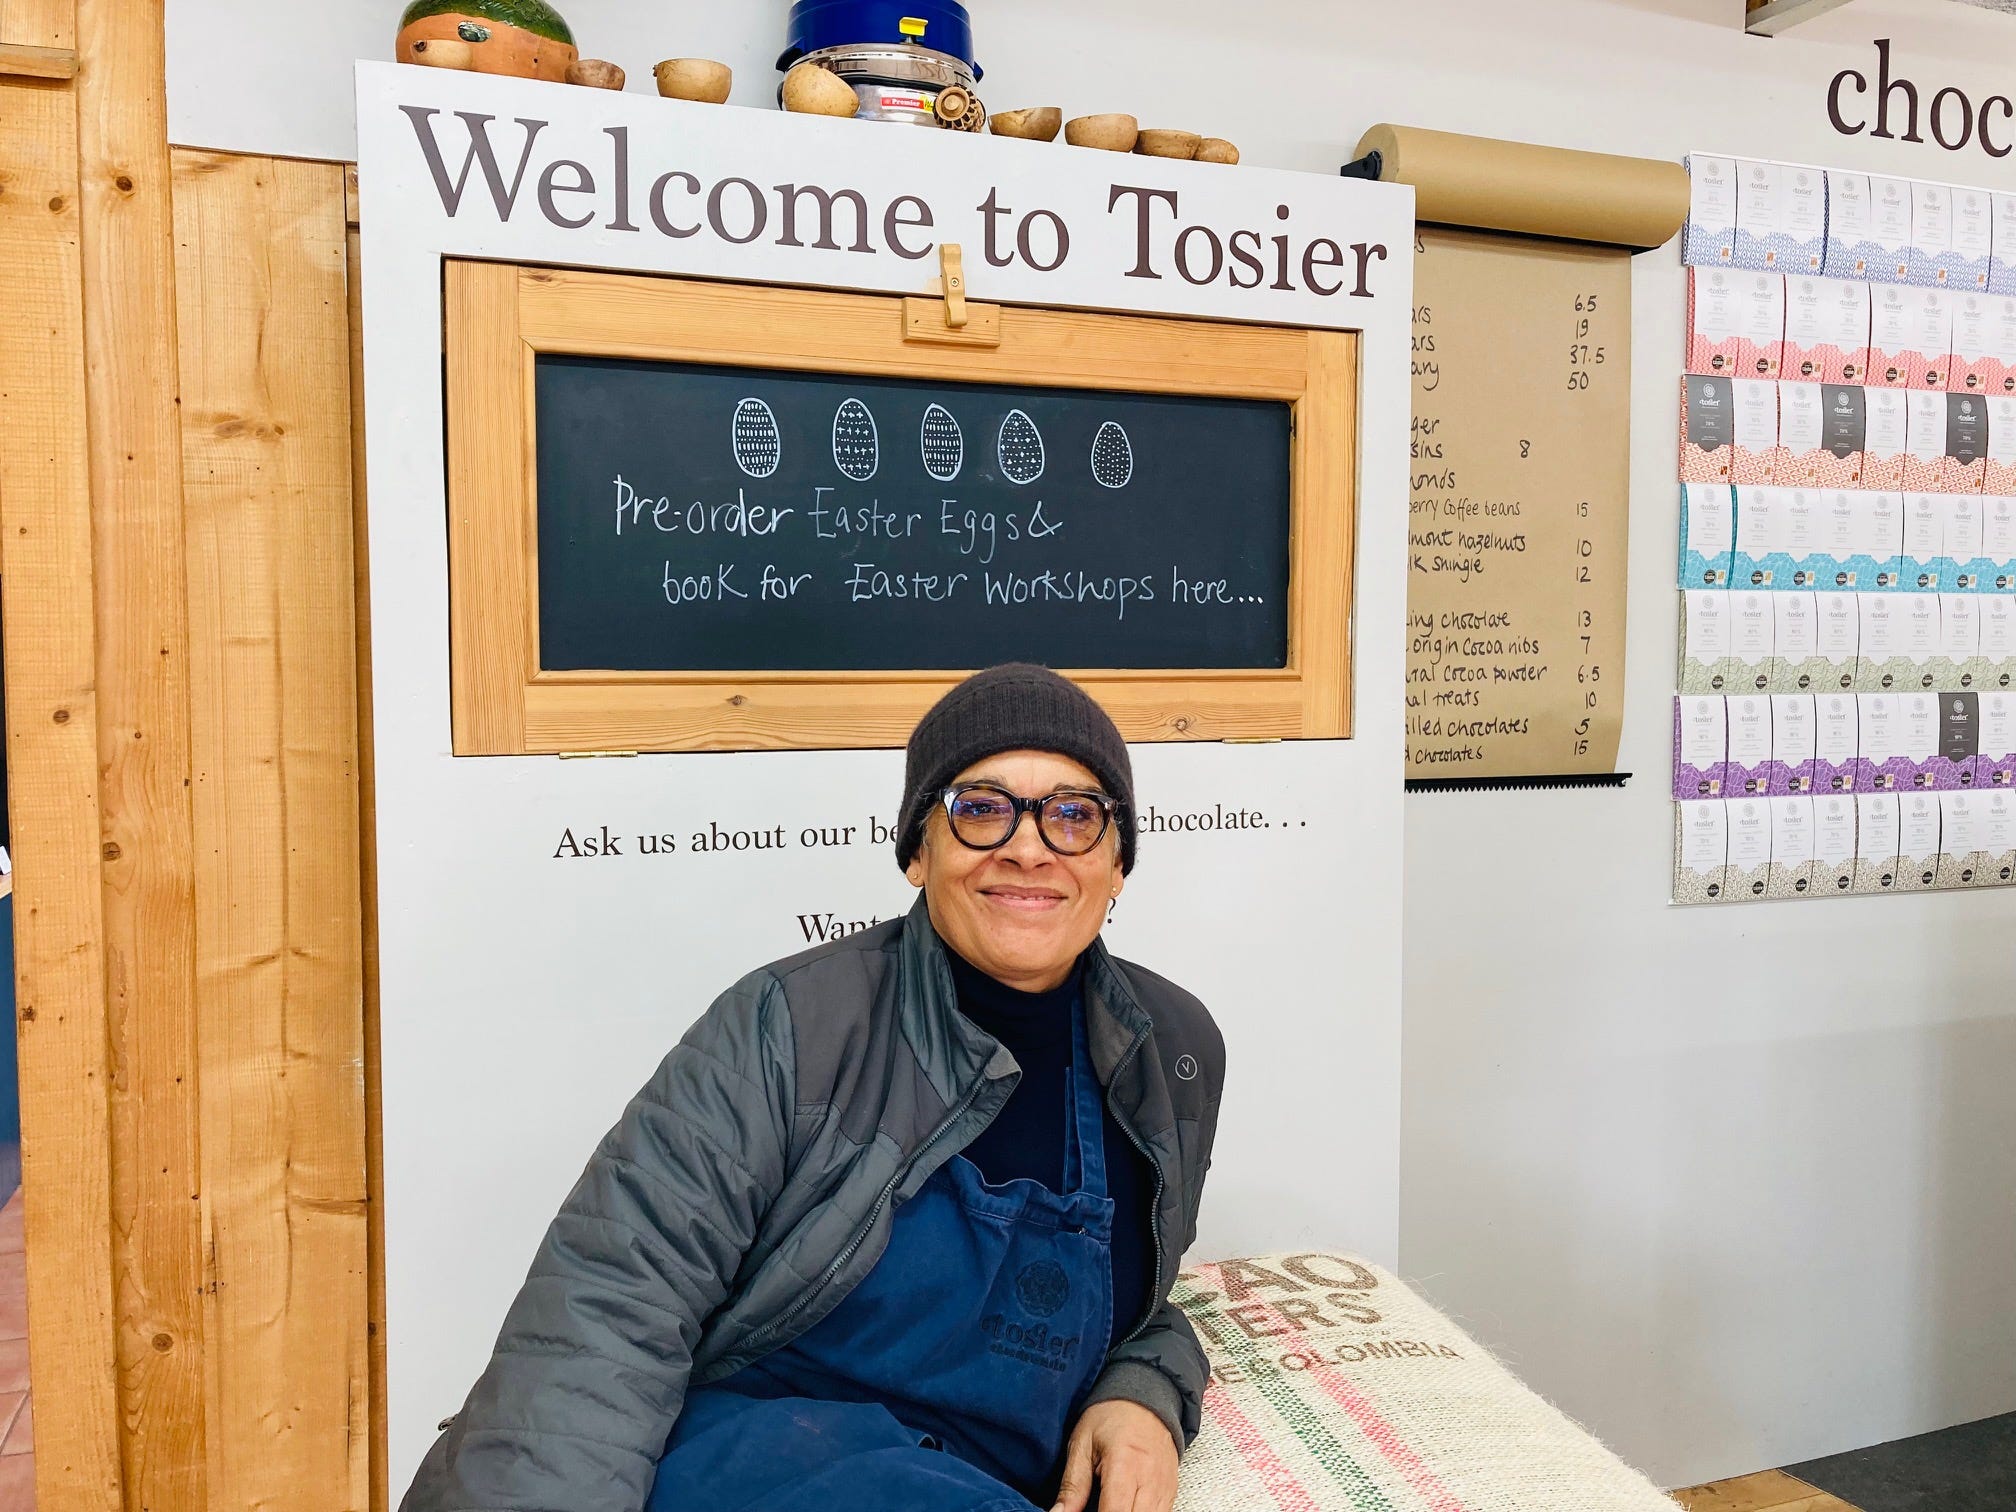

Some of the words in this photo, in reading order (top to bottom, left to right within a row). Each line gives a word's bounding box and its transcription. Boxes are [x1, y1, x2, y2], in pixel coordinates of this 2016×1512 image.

[891, 98, 921, 108] Premier
[1827, 38, 2014, 158] choc
[399, 104, 936, 260] Welcome
[976, 185, 1070, 272] to
[1107, 182, 1388, 298] Tosier
[1575, 294, 1597, 312] 6.5
[1575, 318, 1589, 339] 19
[1567, 371, 1589, 390] 50
[1519, 439, 1530, 458] 8
[612, 473, 796, 537] Pre-order
[808, 486, 922, 539] Easter
[941, 498, 1020, 564] Eggs
[1576, 502, 1589, 518] 15
[1458, 531, 1526, 555] hazelnuts
[1576, 540, 1592, 557] 10
[760, 564, 813, 600] for
[844, 562, 968, 602] Easter
[1576, 566, 1591, 582] 12
[1577, 611, 1592, 627] 13
[1413, 635, 1459, 665] origin
[1508, 635, 1540, 655] nibs
[1580, 636, 1591, 654] 7
[1577, 665, 1600, 683] 6.5
[1433, 688, 1480, 707] treats
[1585, 692, 1597, 708] 10
[1447, 717, 1529, 738] chocolates
[1574, 718, 1590, 736] 5
[1574, 740, 1588, 755] 15
[552, 825, 623, 859] Ask
[637, 832, 676, 855] us
[690, 821, 788, 853] about
[800, 825, 857, 848] our
[1178, 1252, 1379, 1302] AO
